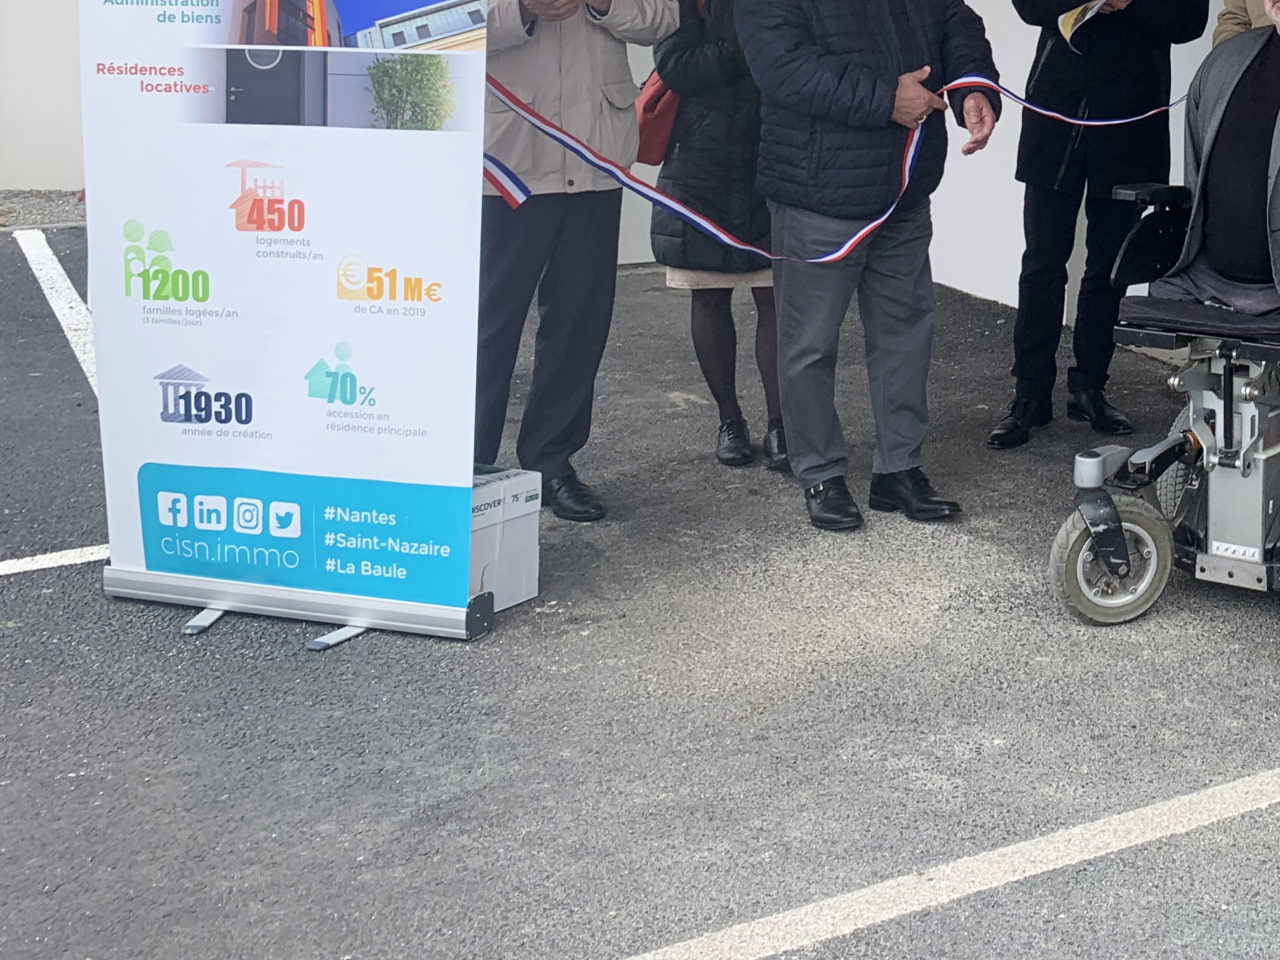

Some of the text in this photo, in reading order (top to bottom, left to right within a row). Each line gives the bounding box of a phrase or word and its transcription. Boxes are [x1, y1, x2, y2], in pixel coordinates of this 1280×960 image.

[157, 10, 221, 25] de biens
[96, 62, 184, 77] Résidences
[140, 80, 209, 94] locatives
[247, 198, 305, 232] 450
[255, 235, 310, 248] logements
[255, 248, 324, 262] construits/an
[137, 269, 210, 303] 1200
[366, 267, 397, 301] 51
[142, 305, 182, 317] familles
[354, 305, 426, 317] de CA en 2019
[325, 371, 376, 406] 70%
[178, 391, 253, 425] 1930
[326, 409, 390, 421] accession en
[181, 428, 273, 440] année de création
[326, 422, 427, 438] résidence principale
[198, 501, 222, 525] in
[324, 505, 397, 525] #Nantes
[161, 533, 300, 569] cisn.immo
[324, 532, 451, 557] #Saint-Nazaire
[325, 558, 407, 579] #La Baule
